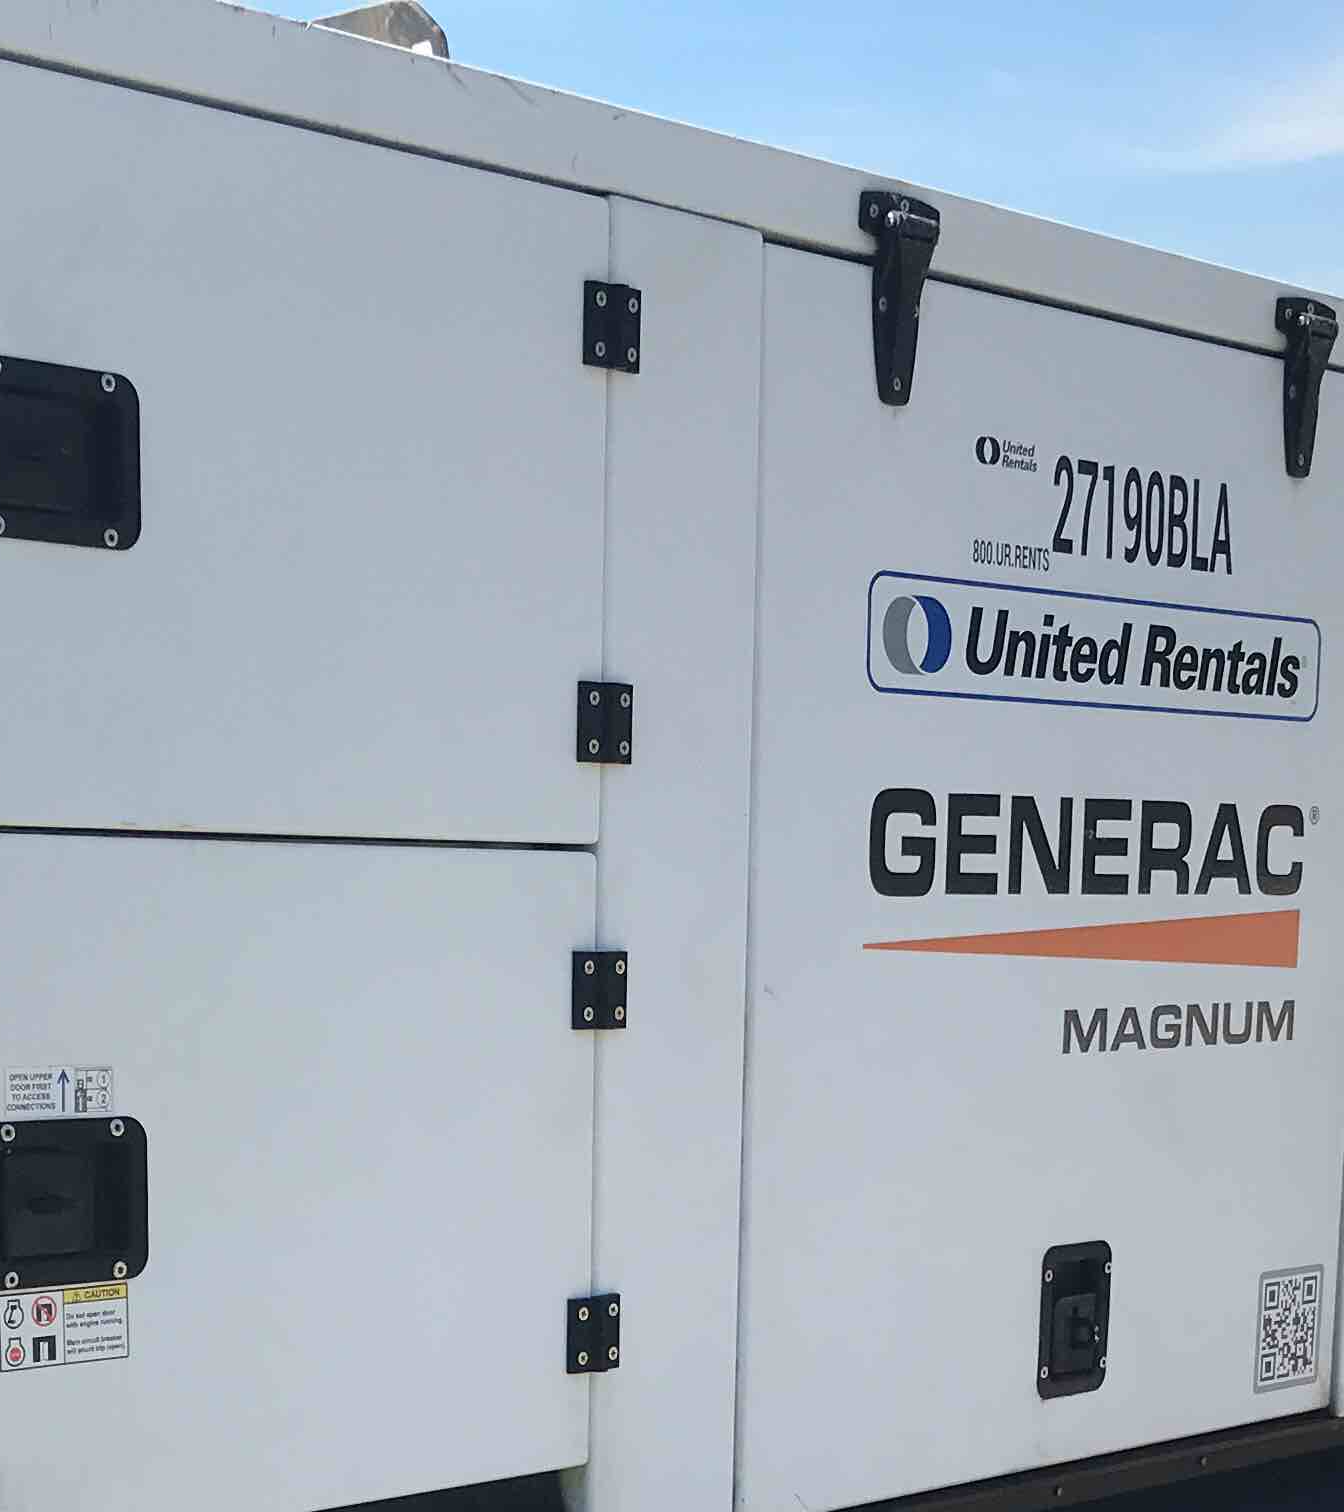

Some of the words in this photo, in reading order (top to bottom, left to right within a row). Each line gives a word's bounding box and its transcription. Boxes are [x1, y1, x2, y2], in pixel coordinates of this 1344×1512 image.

[1002, 439, 1036, 457] United
[1002, 454, 1038, 472] Rentals
[1052, 455, 1233, 576] 27190BLA
[972, 539, 1050, 572] 800.UR.RENTS
[965, 605, 1133, 686] United
[1139, 623, 1301, 699] Rentals
[868, 787, 1305, 898] GENERAC
[1061, 1000, 1296, 1055] MAGNUM
[84, 1287, 120, 1299] CAUTION
